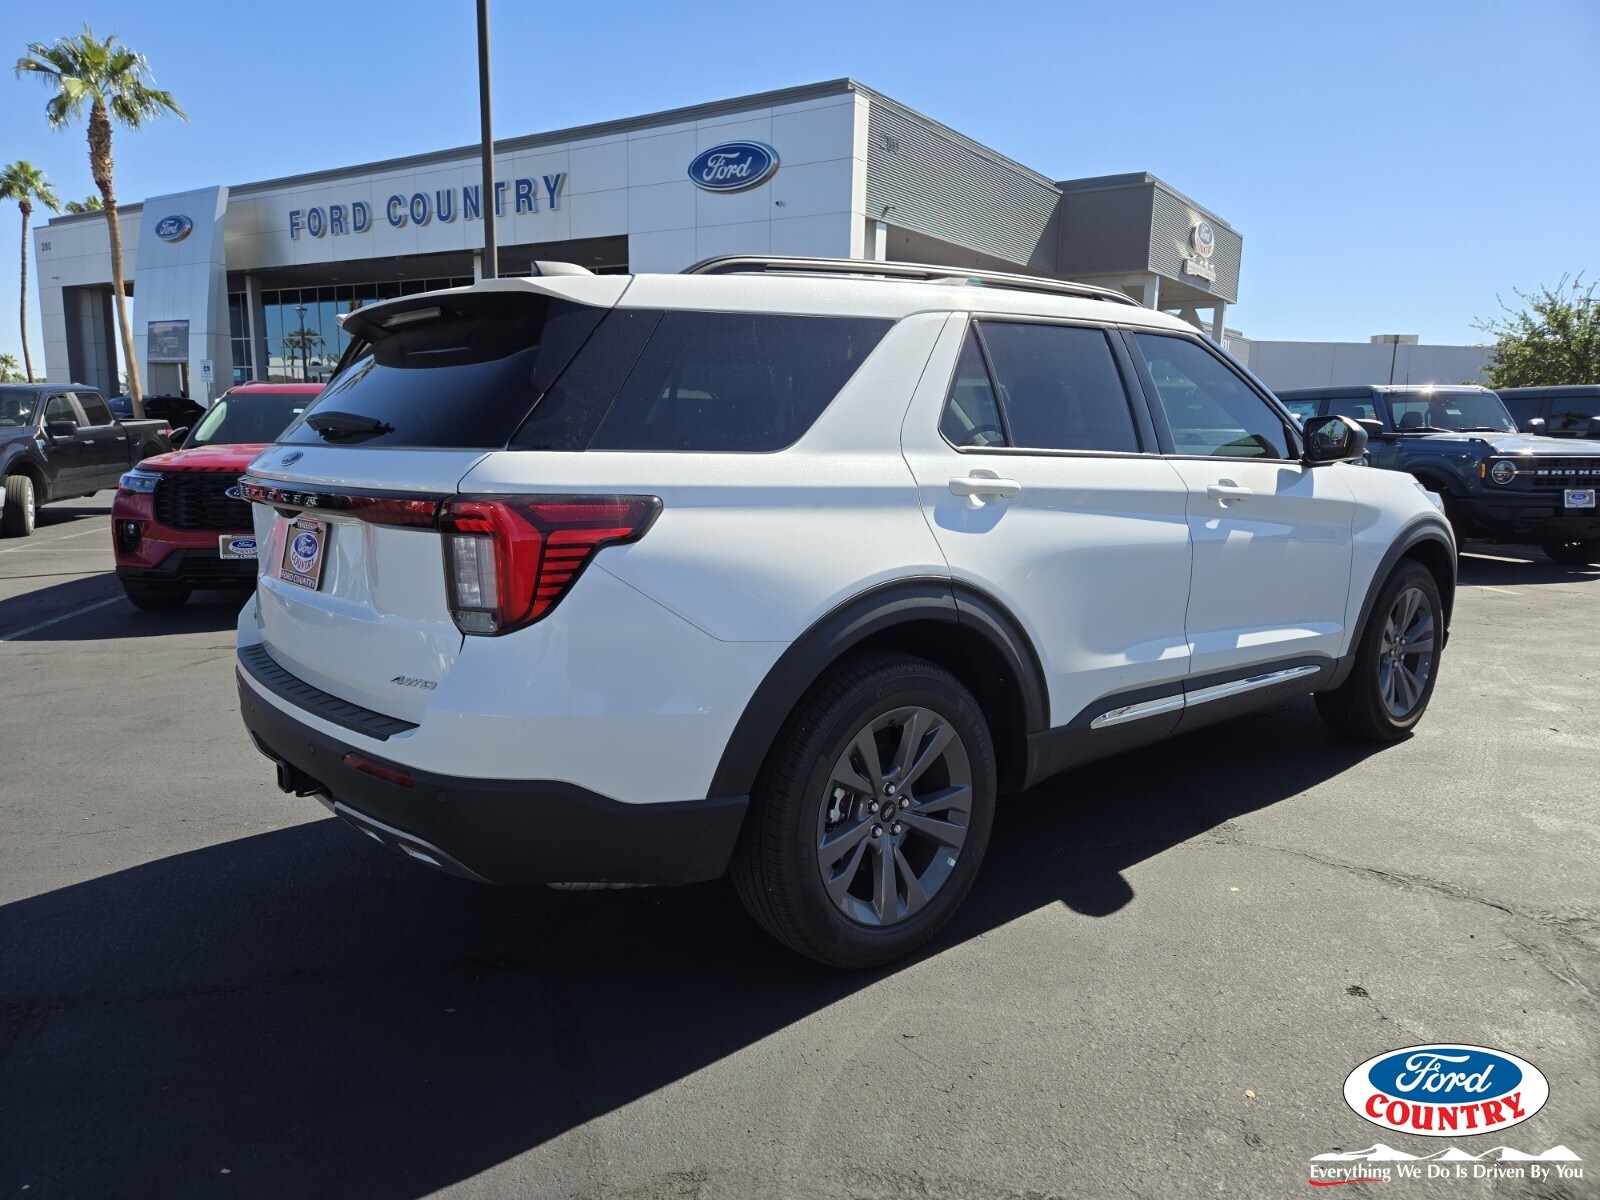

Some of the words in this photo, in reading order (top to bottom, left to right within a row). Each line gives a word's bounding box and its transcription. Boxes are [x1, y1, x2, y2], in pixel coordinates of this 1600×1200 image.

[702, 152, 752, 181] Ford
[289, 202, 369, 239] FORD
[387, 173, 564, 227] COUNTRY
[159, 220, 180, 235] Ford
[41, 241, 52, 251] 280
[298, 537, 316, 554] Ford
[292, 553, 315, 570] COUNTRY
[281, 570, 294, 581] FORD
[294, 574, 315, 589] COUNTRY
